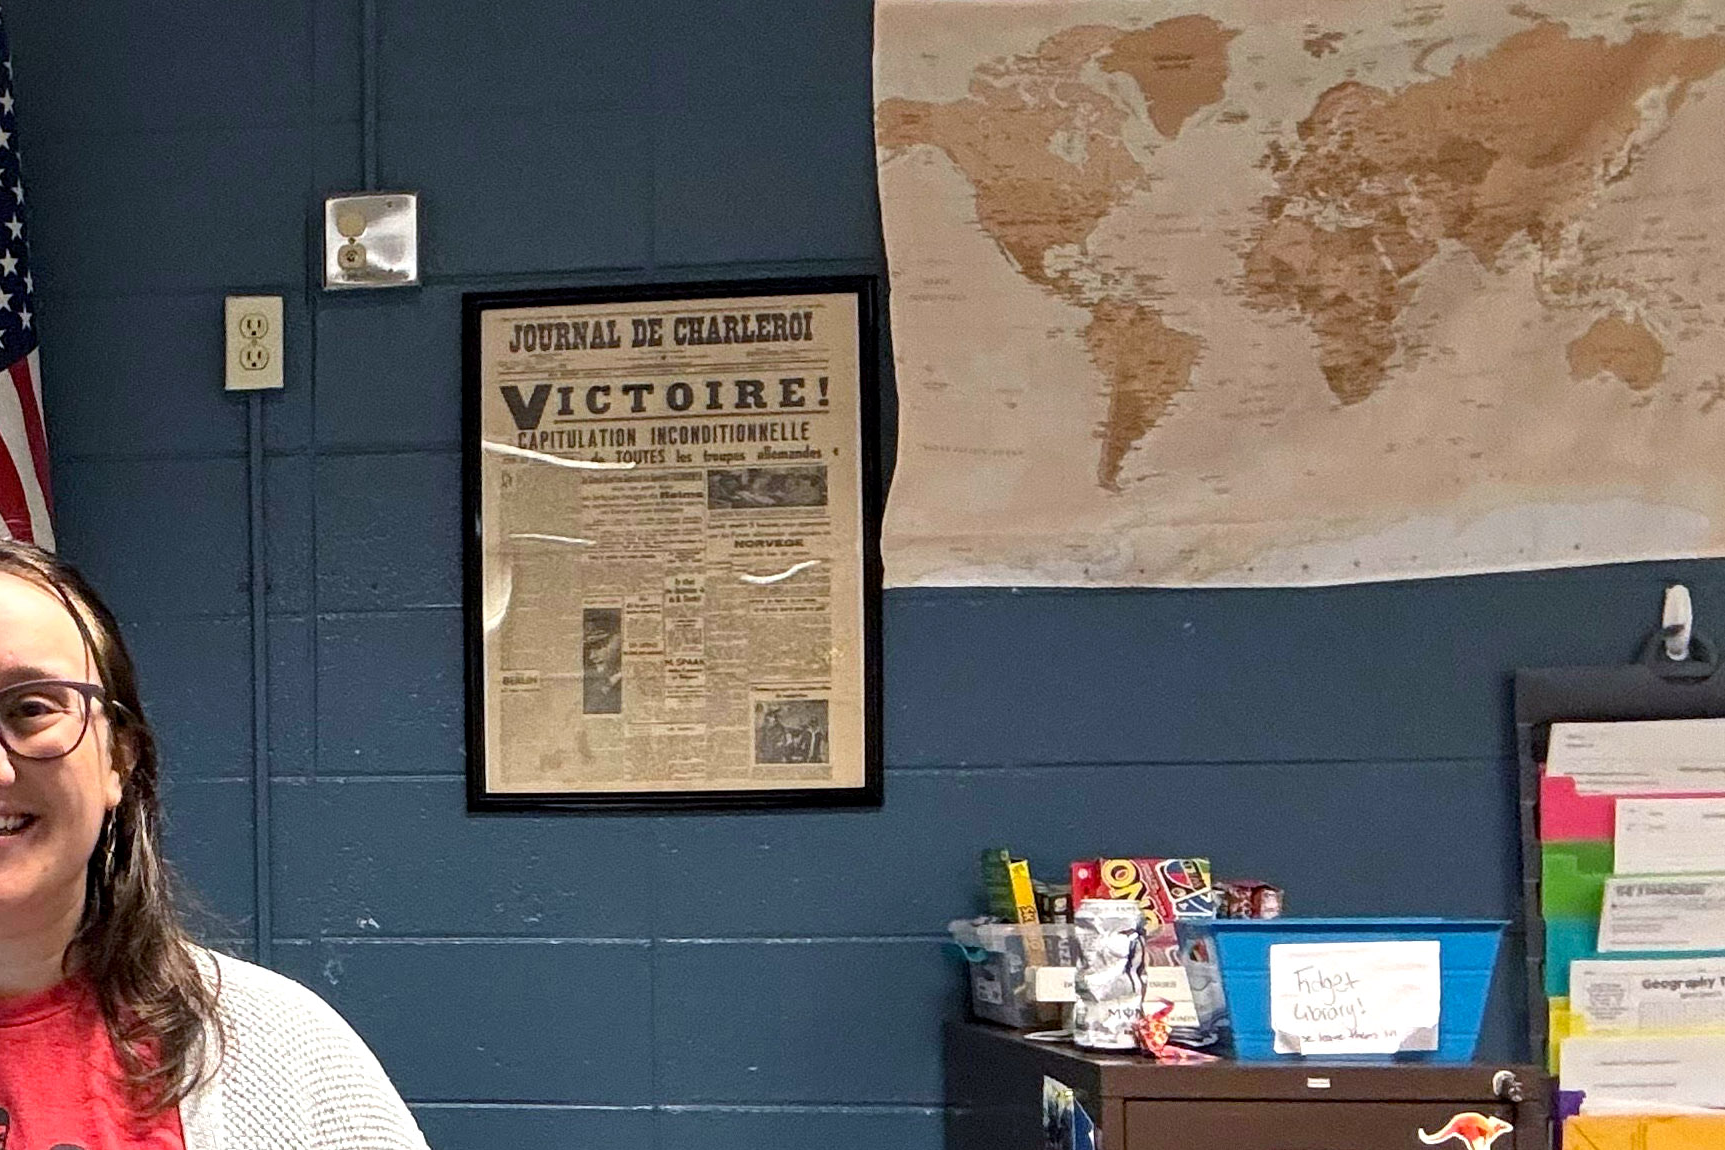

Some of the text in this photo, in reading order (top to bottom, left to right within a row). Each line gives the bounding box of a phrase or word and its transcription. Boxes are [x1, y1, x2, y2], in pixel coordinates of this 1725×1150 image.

[509, 311, 813, 353] JOURNAL DE CHARLEROI
[499, 376, 829, 431] VICTOIRE!
[517, 421, 811, 451] CAPITULATION INCONDITIONNELLE
[616, 449, 666, 465] TOUTES
[676, 449, 693, 463] les
[703, 449, 746, 464] troupes
[757, 445, 822, 460] allemandes
[1293, 965, 1360, 1007] Fidget
[1642, 975, 1716, 991] Geography
